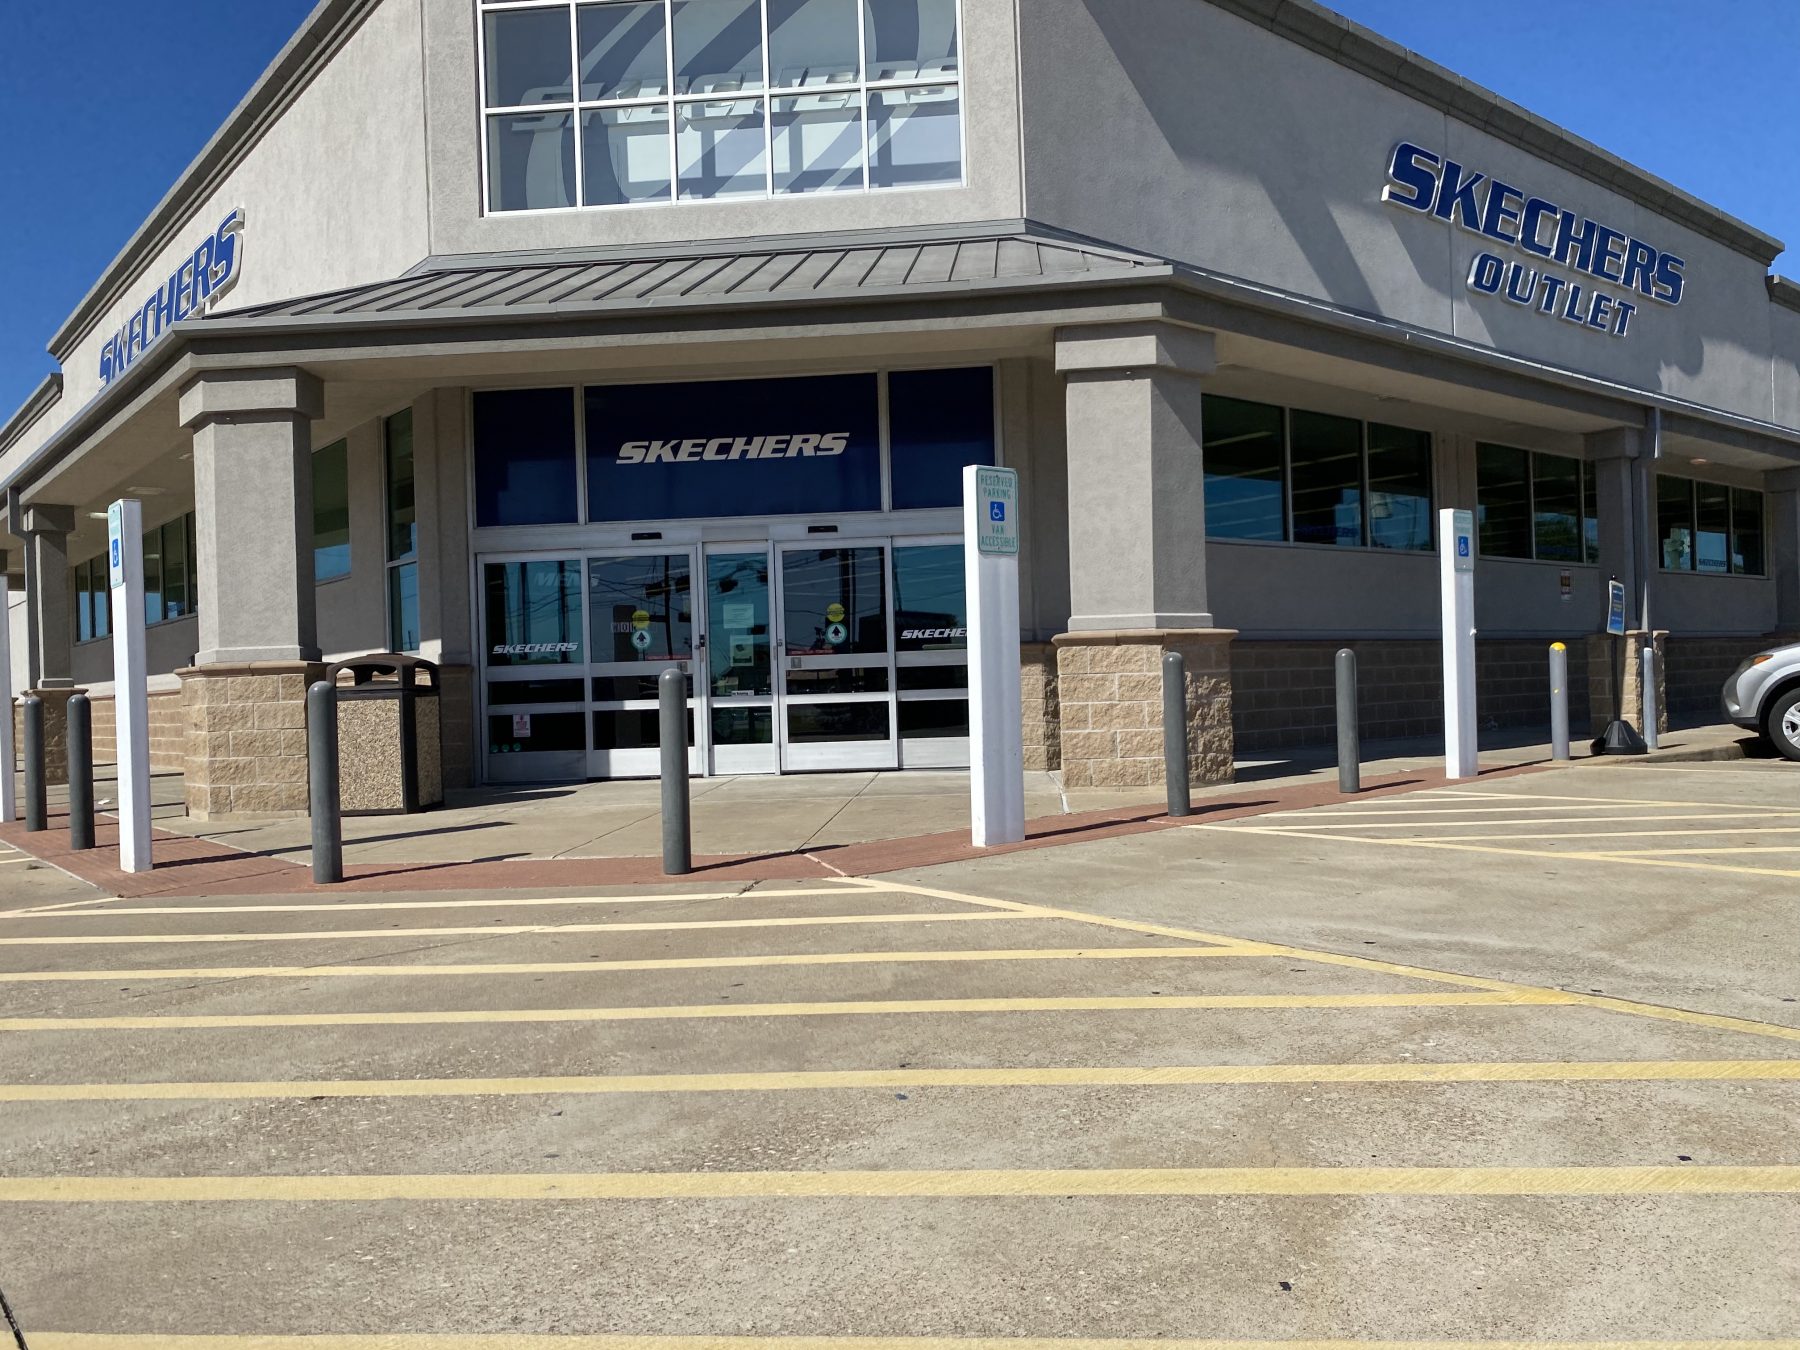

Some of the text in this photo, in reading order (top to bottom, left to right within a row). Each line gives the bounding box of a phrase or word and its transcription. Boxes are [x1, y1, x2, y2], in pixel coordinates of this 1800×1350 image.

[1381, 141, 1686, 306] SKECHERS
[99, 207, 246, 391] SKECHERS
[1467, 252, 1637, 337] OUTLET
[615, 432, 850, 465] SKECHERS
[981, 475, 1012, 487] RESERVED
[983, 487, 1011, 499] PARKING
[992, 525, 1004, 534] VAN
[981, 536, 1015, 547] ACCESSIBLE
[900, 627, 967, 639] SKECHE
[492, 642, 579, 654] SKECHERS
